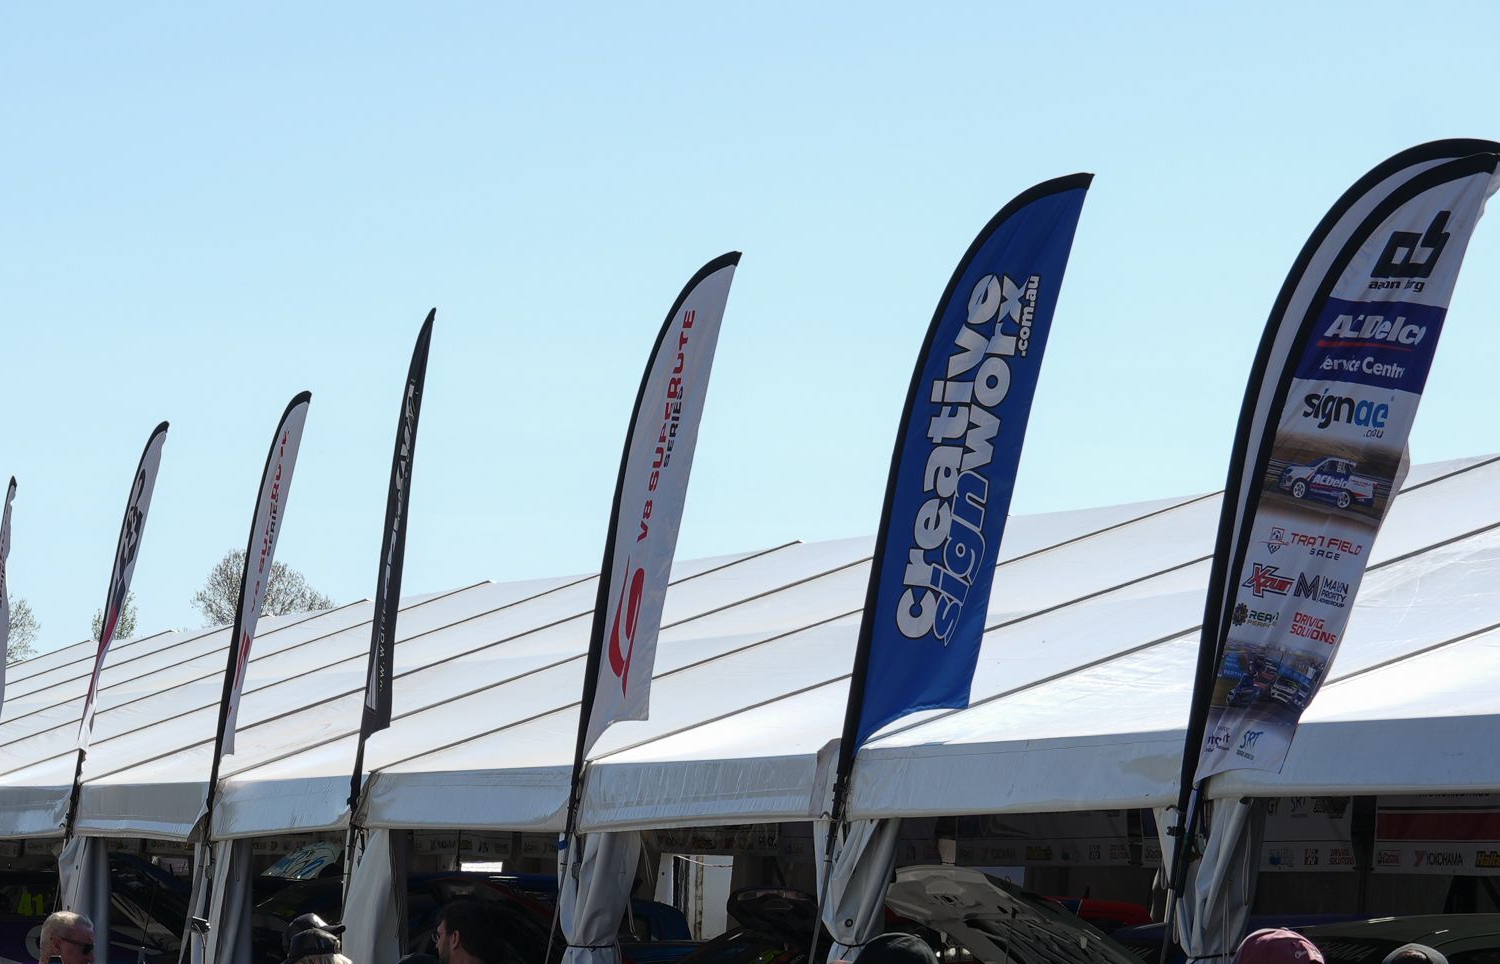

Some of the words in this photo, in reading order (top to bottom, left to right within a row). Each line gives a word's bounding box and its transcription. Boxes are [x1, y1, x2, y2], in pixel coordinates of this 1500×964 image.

[1020, 274, 1041, 357] .com.au
[895, 272, 1003, 640] creative
[636, 501, 654, 543] V8
[1426, 851, 1464, 867] YOKOHAMA
